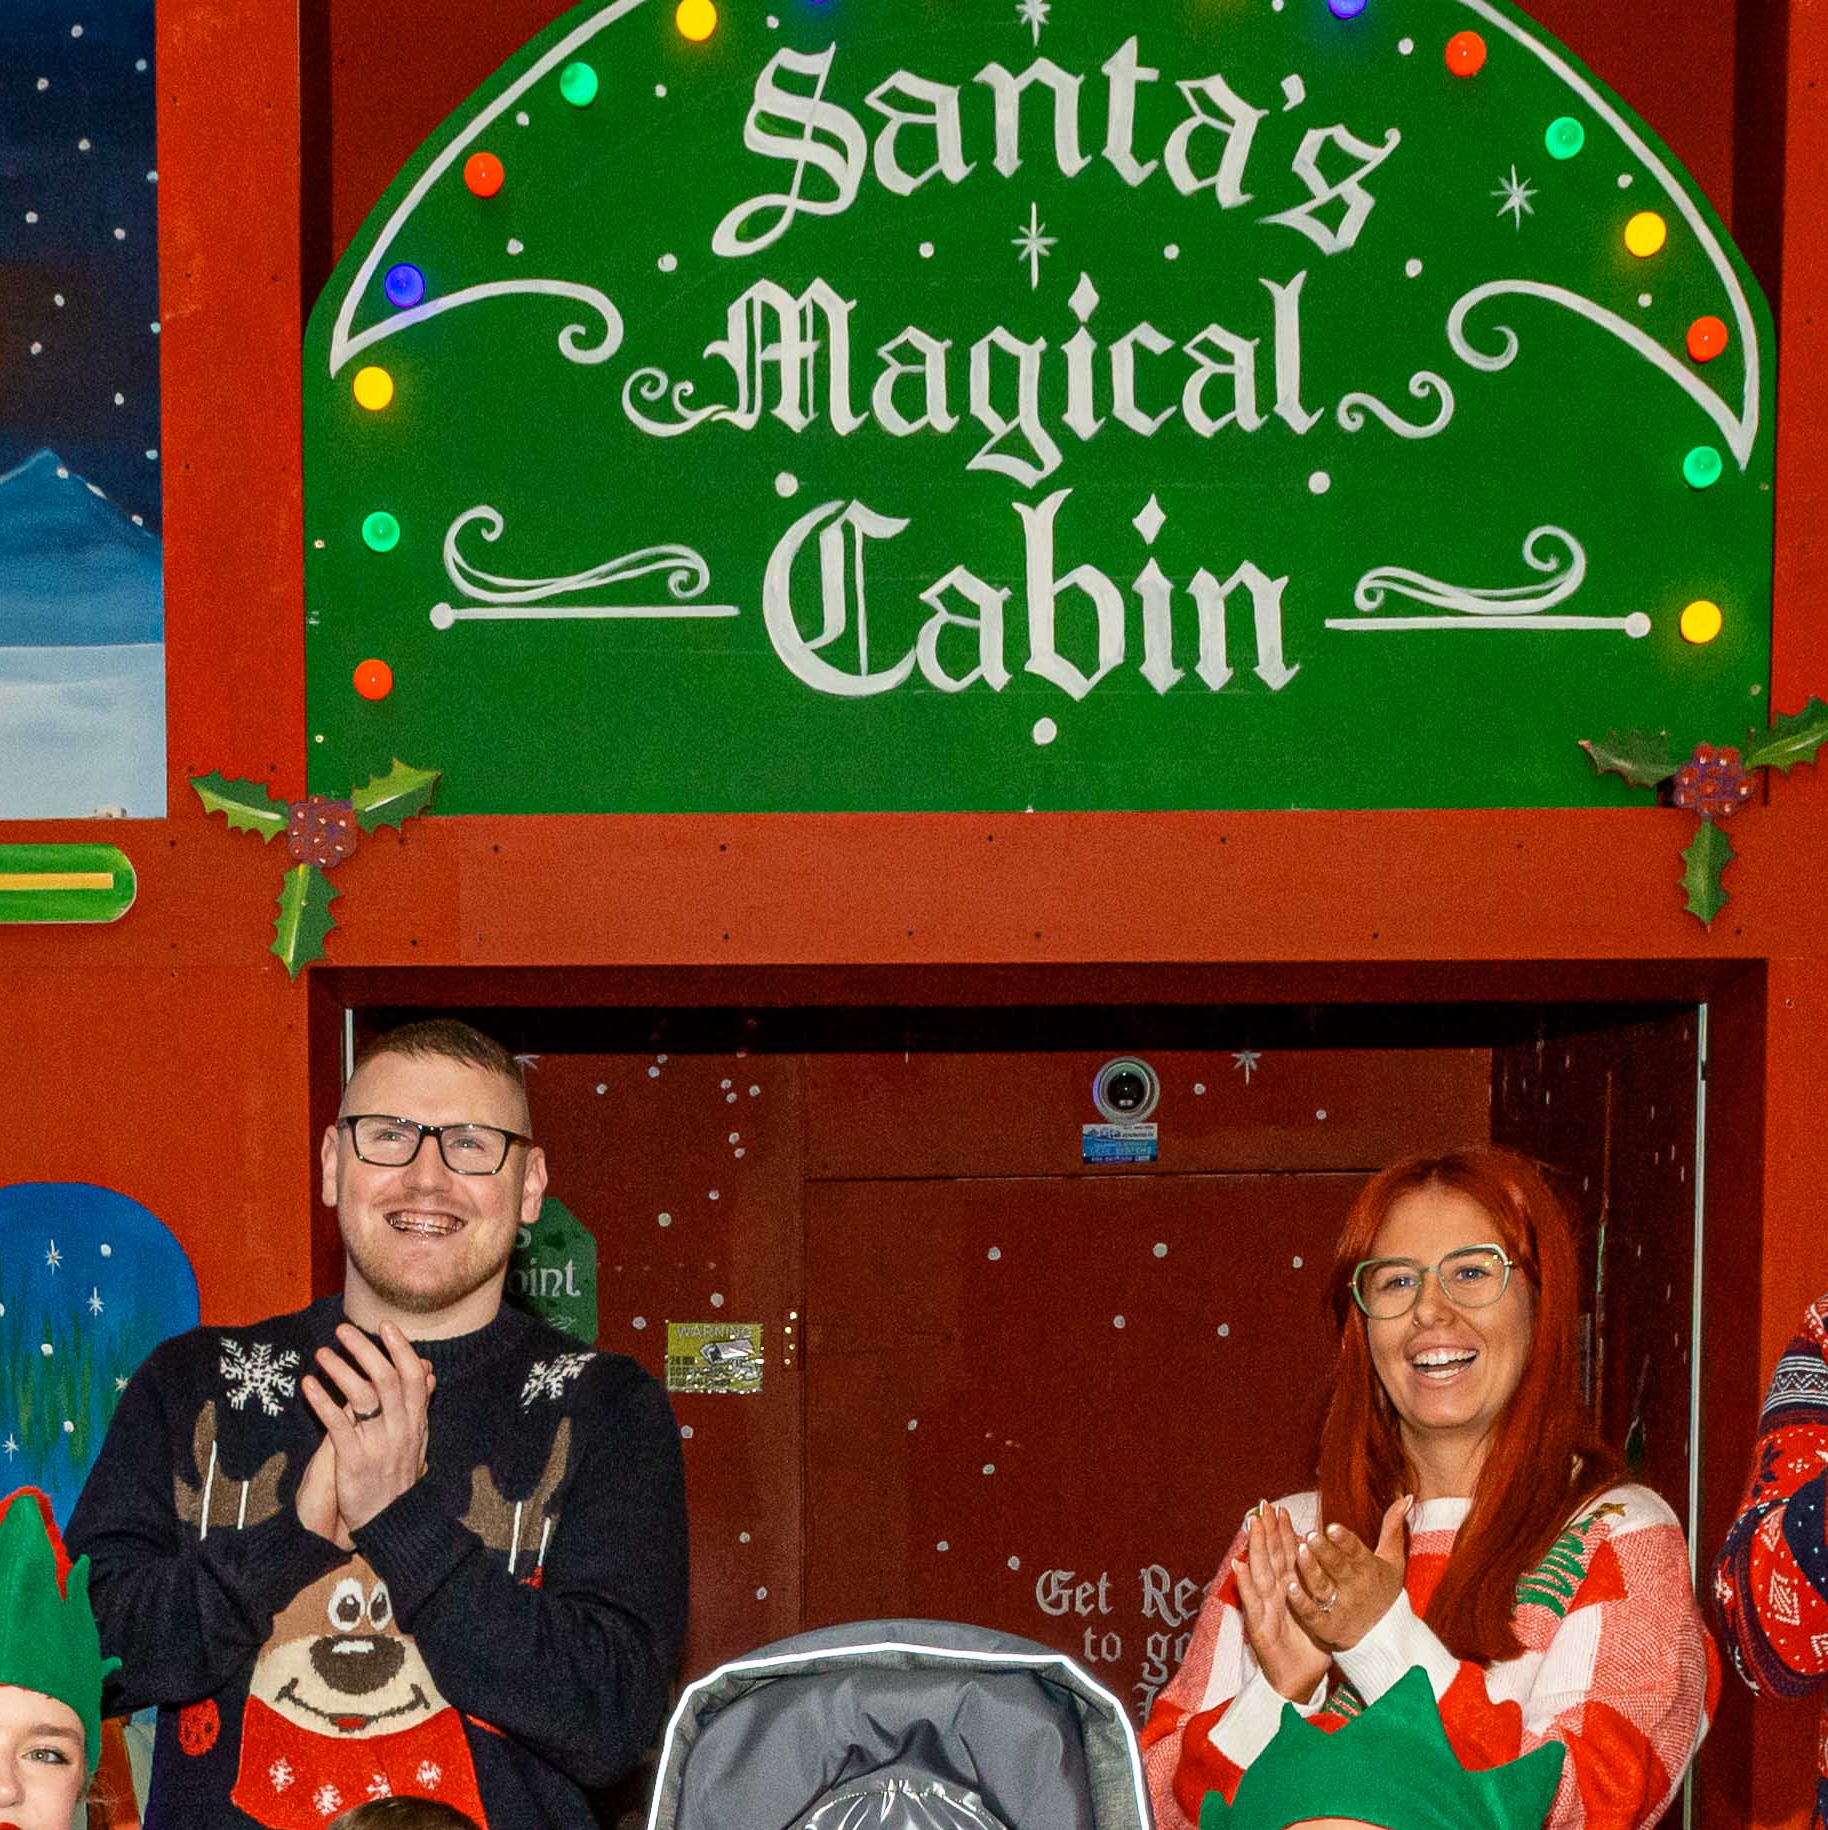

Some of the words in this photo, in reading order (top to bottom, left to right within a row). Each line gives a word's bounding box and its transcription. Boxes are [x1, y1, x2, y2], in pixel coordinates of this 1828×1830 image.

[711, 35, 1401, 256] Santa's
[702, 270, 1325, 489] Magical
[762, 487, 1300, 701] Cabin
[676, 1324, 754, 1338] WARNING
[1035, 1568, 1114, 1617] Get
[1139, 1564, 1212, 1627] Re
[1083, 1626, 1122, 1663] to
